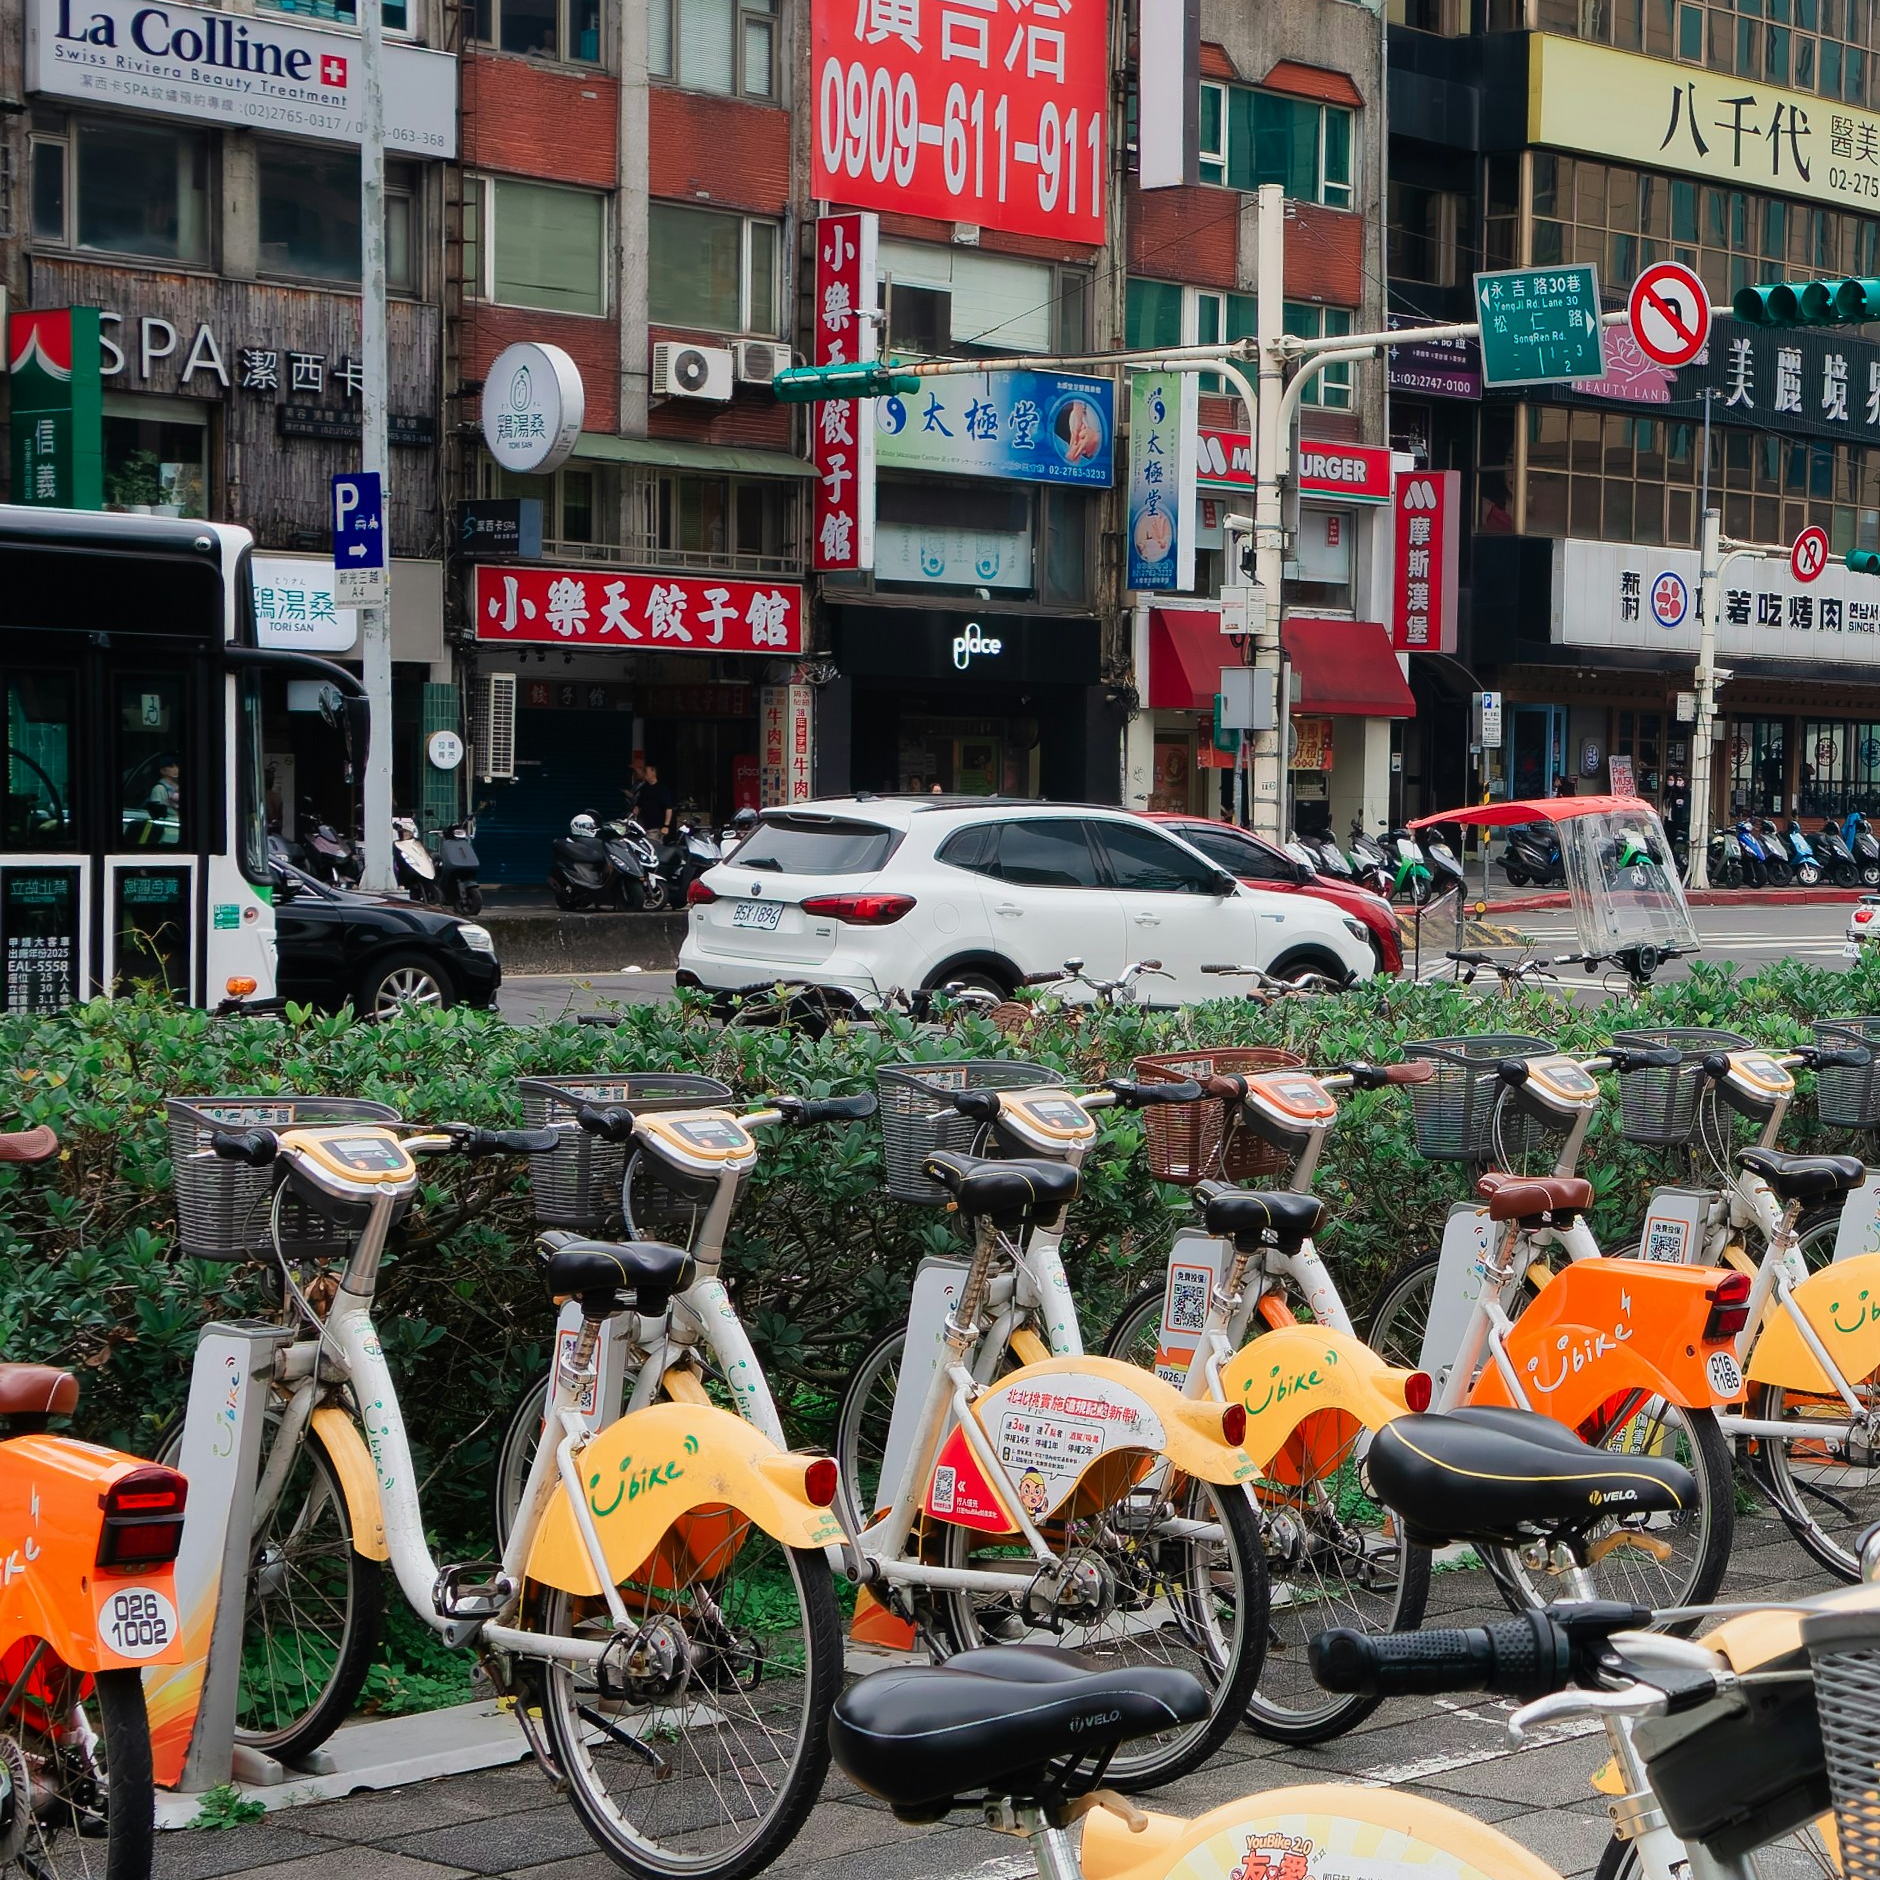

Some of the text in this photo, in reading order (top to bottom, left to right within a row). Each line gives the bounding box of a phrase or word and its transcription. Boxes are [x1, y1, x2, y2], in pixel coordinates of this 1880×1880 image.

[131, 9, 312, 81] Colline
[55, 44, 347, 107] Swiss Riviera Beauty Treatment
[820, 57, 1100, 218] 0909-611-911
[1660, 82, 1812, 183] 八千代
[1491, 275, 1581, 299] 永吉路30巷
[1566, 296, 1579, 306] 30
[1493, 309, 1584, 334] 松仁路
[98, 311, 230, 387] SPA
[1552, 330, 1567, 341] Rd.
[1576, 380, 1671, 403] BEAUTY LAND
[921, 391, 1040, 449] 太極堂
[35, 419, 55, 499] 信義
[1143, 429, 1165, 517] 太極堂
[336, 483, 359, 532] P
[1407, 517, 1431, 644] 摩斯漢堡
[1621, 571, 1640, 622] 新村
[488, 575, 791, 647] 小樂天餃子館
[294, 623, 314, 632] SAN
[1848, 622, 1875, 633] SINCE
[954, 623, 1002, 670] place
[767, 707, 782, 766] 牛肉麵
[733, 901, 780, 926] BSX-1896
[8, 961, 68, 972] EAL-5558
[40, 973, 53, 982] 25
[60, 973, 70, 983] 人
[8, 984, 70, 994] 立位 30 人
[1712, 1357, 1732, 1375] 016
[1713, 1373, 1740, 1392] 1186
[114, 1593, 156, 1619] 026
[112, 1619, 168, 1648] 1002
[1246, 1833, 1314, 1856] YouBike 2.0
